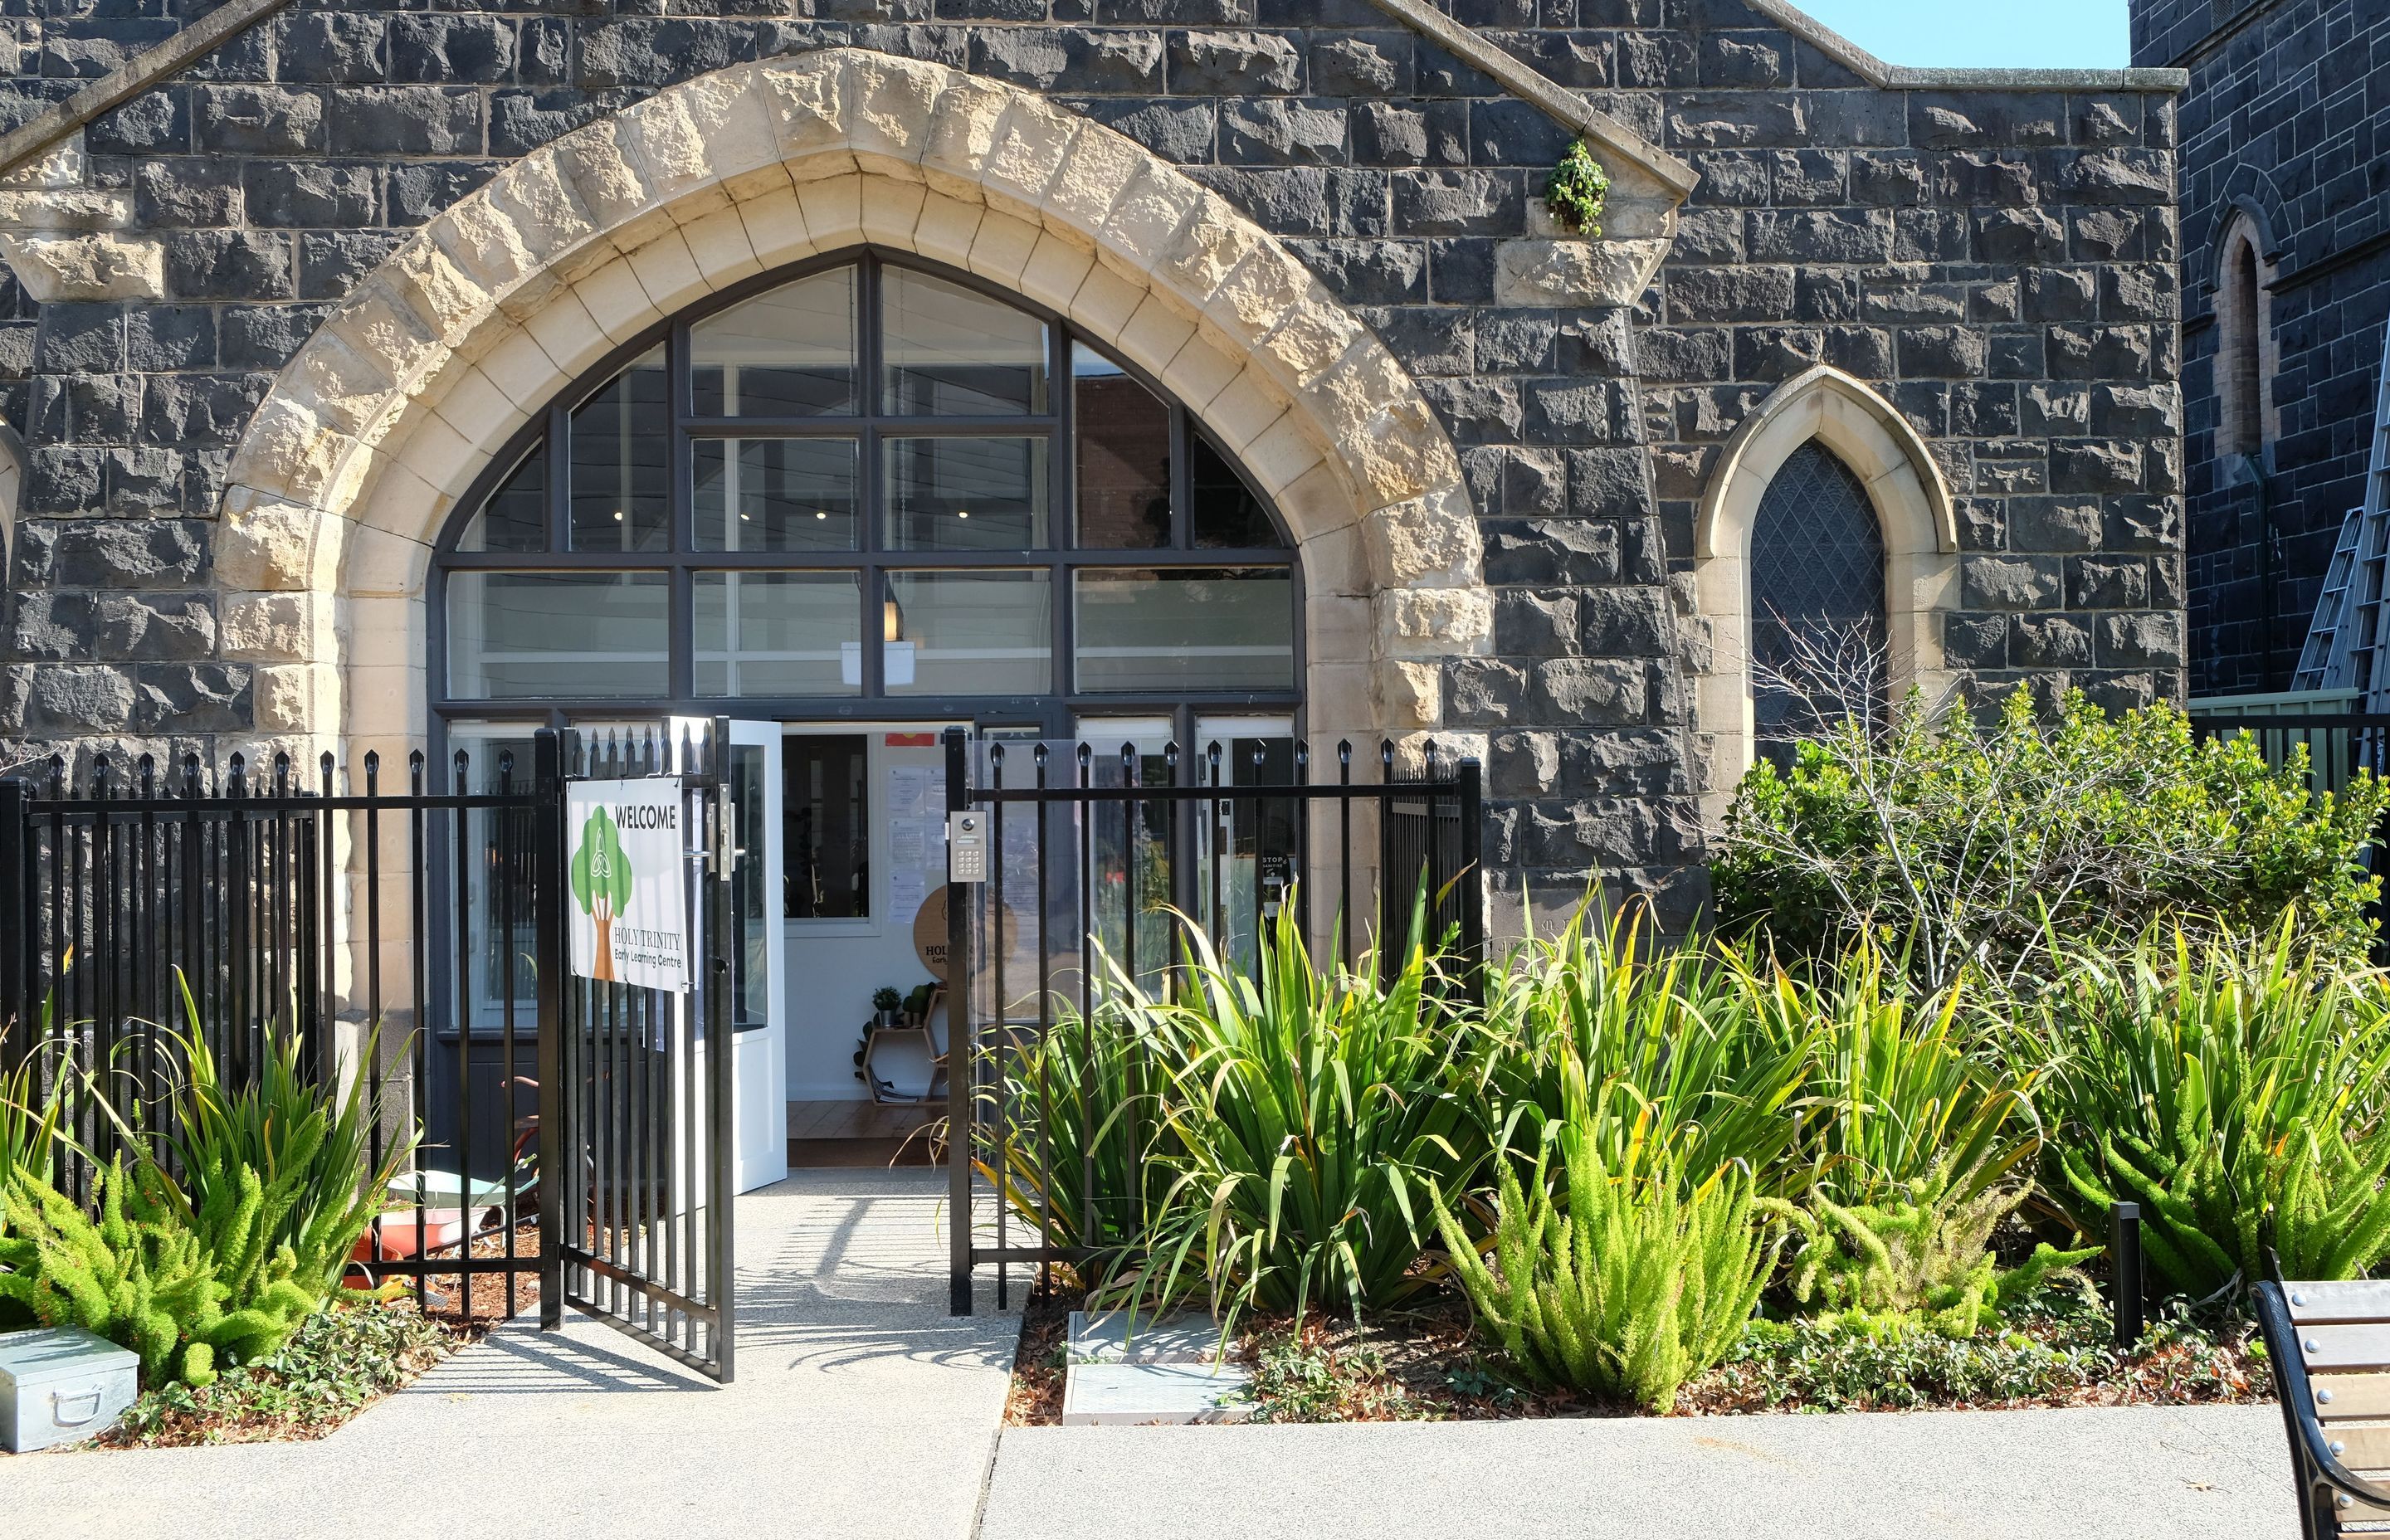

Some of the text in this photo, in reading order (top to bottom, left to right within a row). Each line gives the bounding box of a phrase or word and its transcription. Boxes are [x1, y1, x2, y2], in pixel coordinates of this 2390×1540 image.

[615, 805, 676, 830] WELCOME
[614, 927, 680, 951] HOLY TRINITY
[614, 948, 682, 969] Early Learning Centre
[925, 946, 947, 955] HOL
